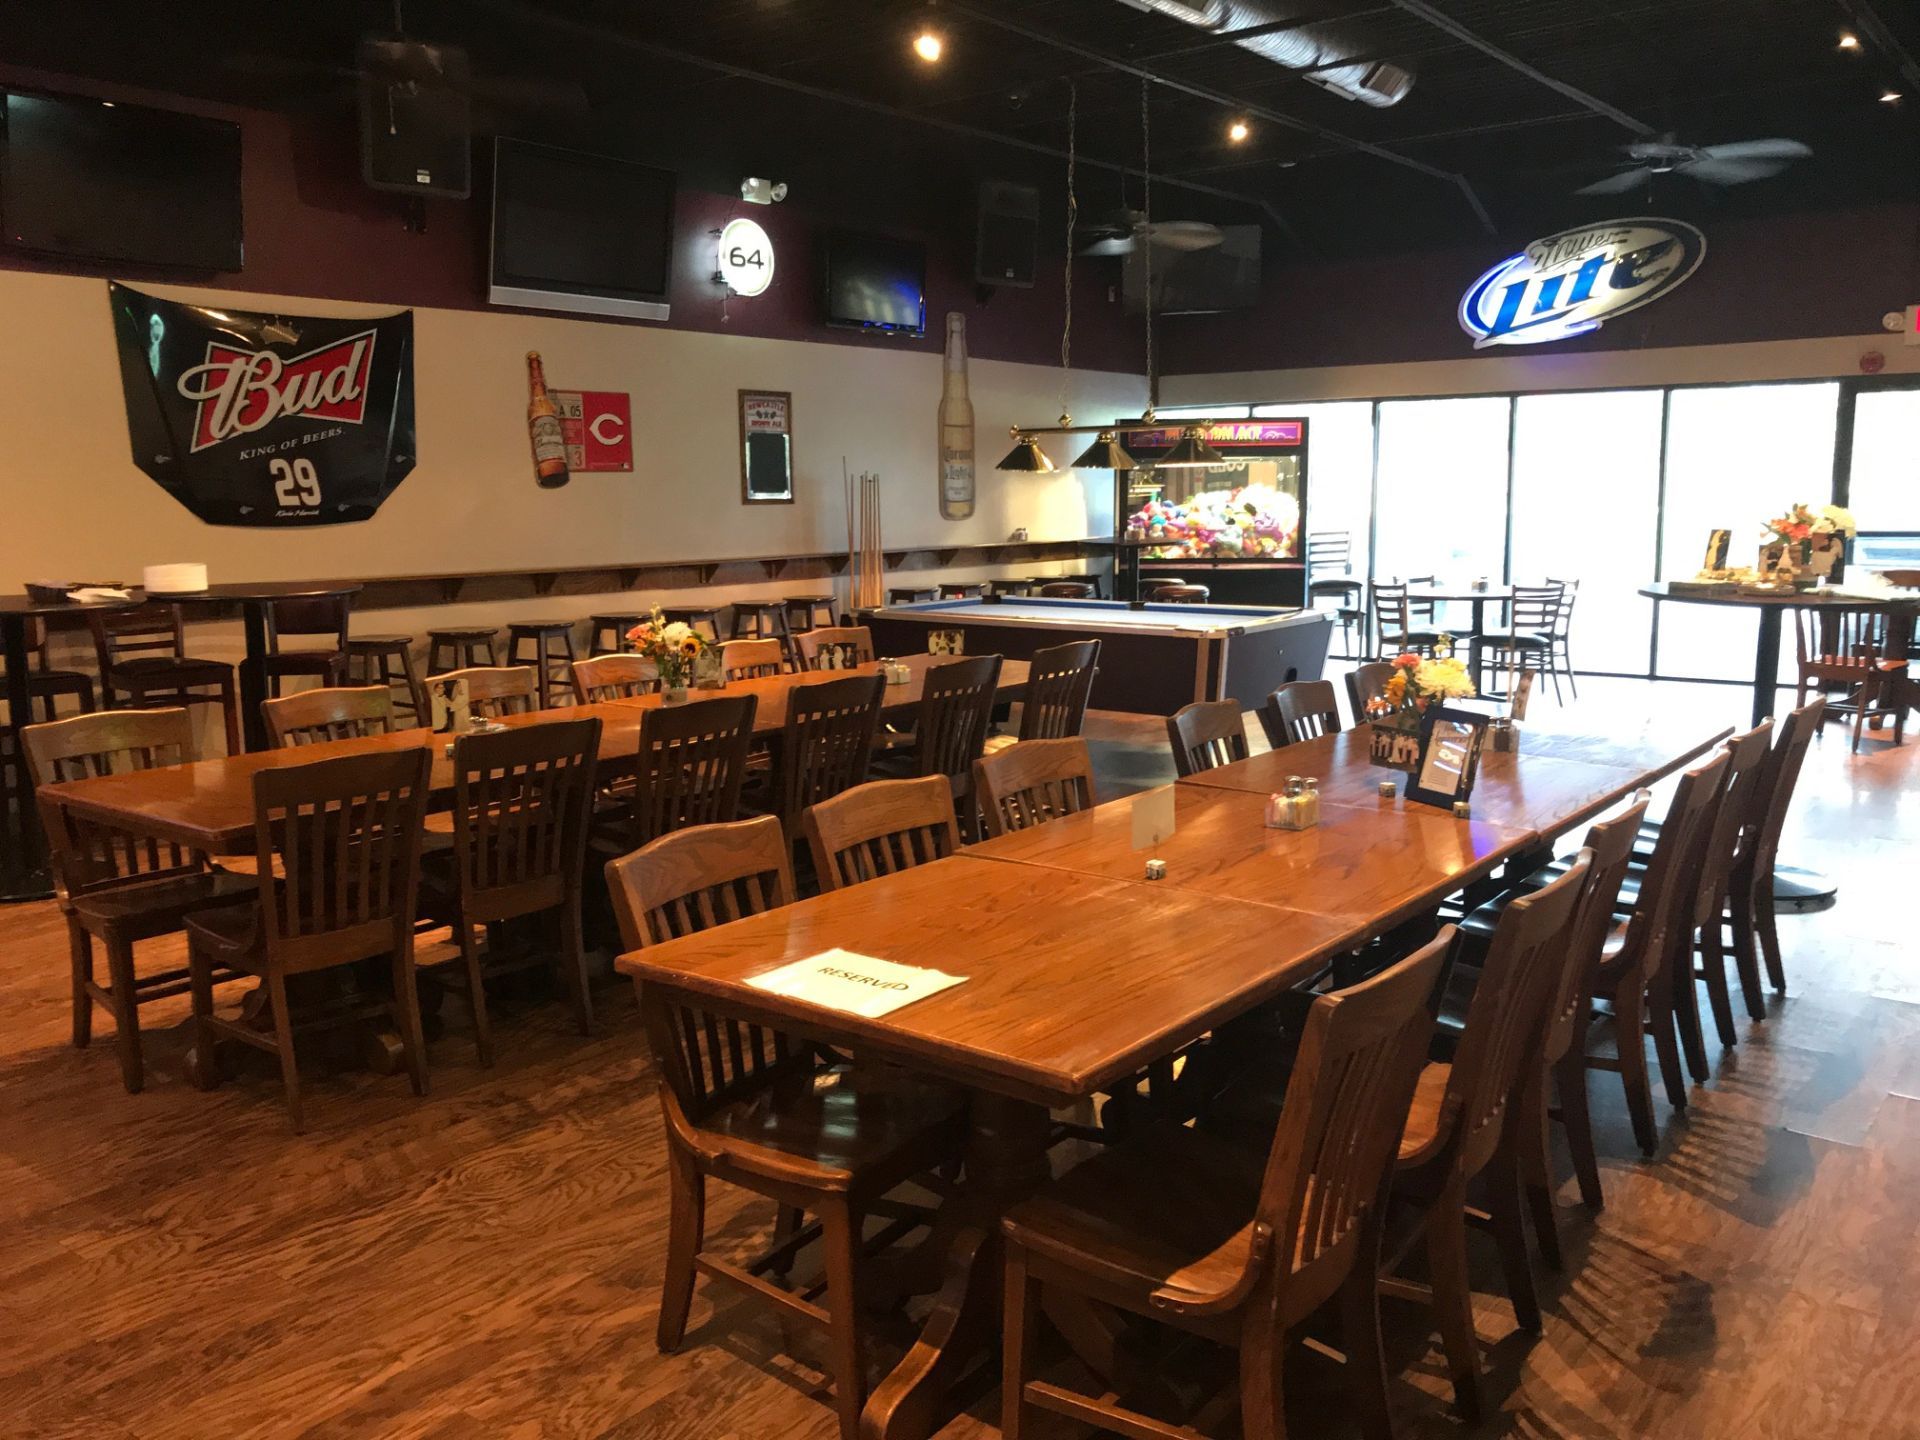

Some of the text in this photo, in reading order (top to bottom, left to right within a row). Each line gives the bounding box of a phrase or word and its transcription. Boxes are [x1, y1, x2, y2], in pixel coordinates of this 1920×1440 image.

[729, 246, 765, 270] 64
[1528, 229, 1633, 272] Miller
[1481, 238, 1677, 342] Lite
[177, 340, 368, 439] Bud
[570, 405, 581, 417] 05
[240, 426, 343, 460] KING OF BEERS
[269, 458, 322, 506] 29
